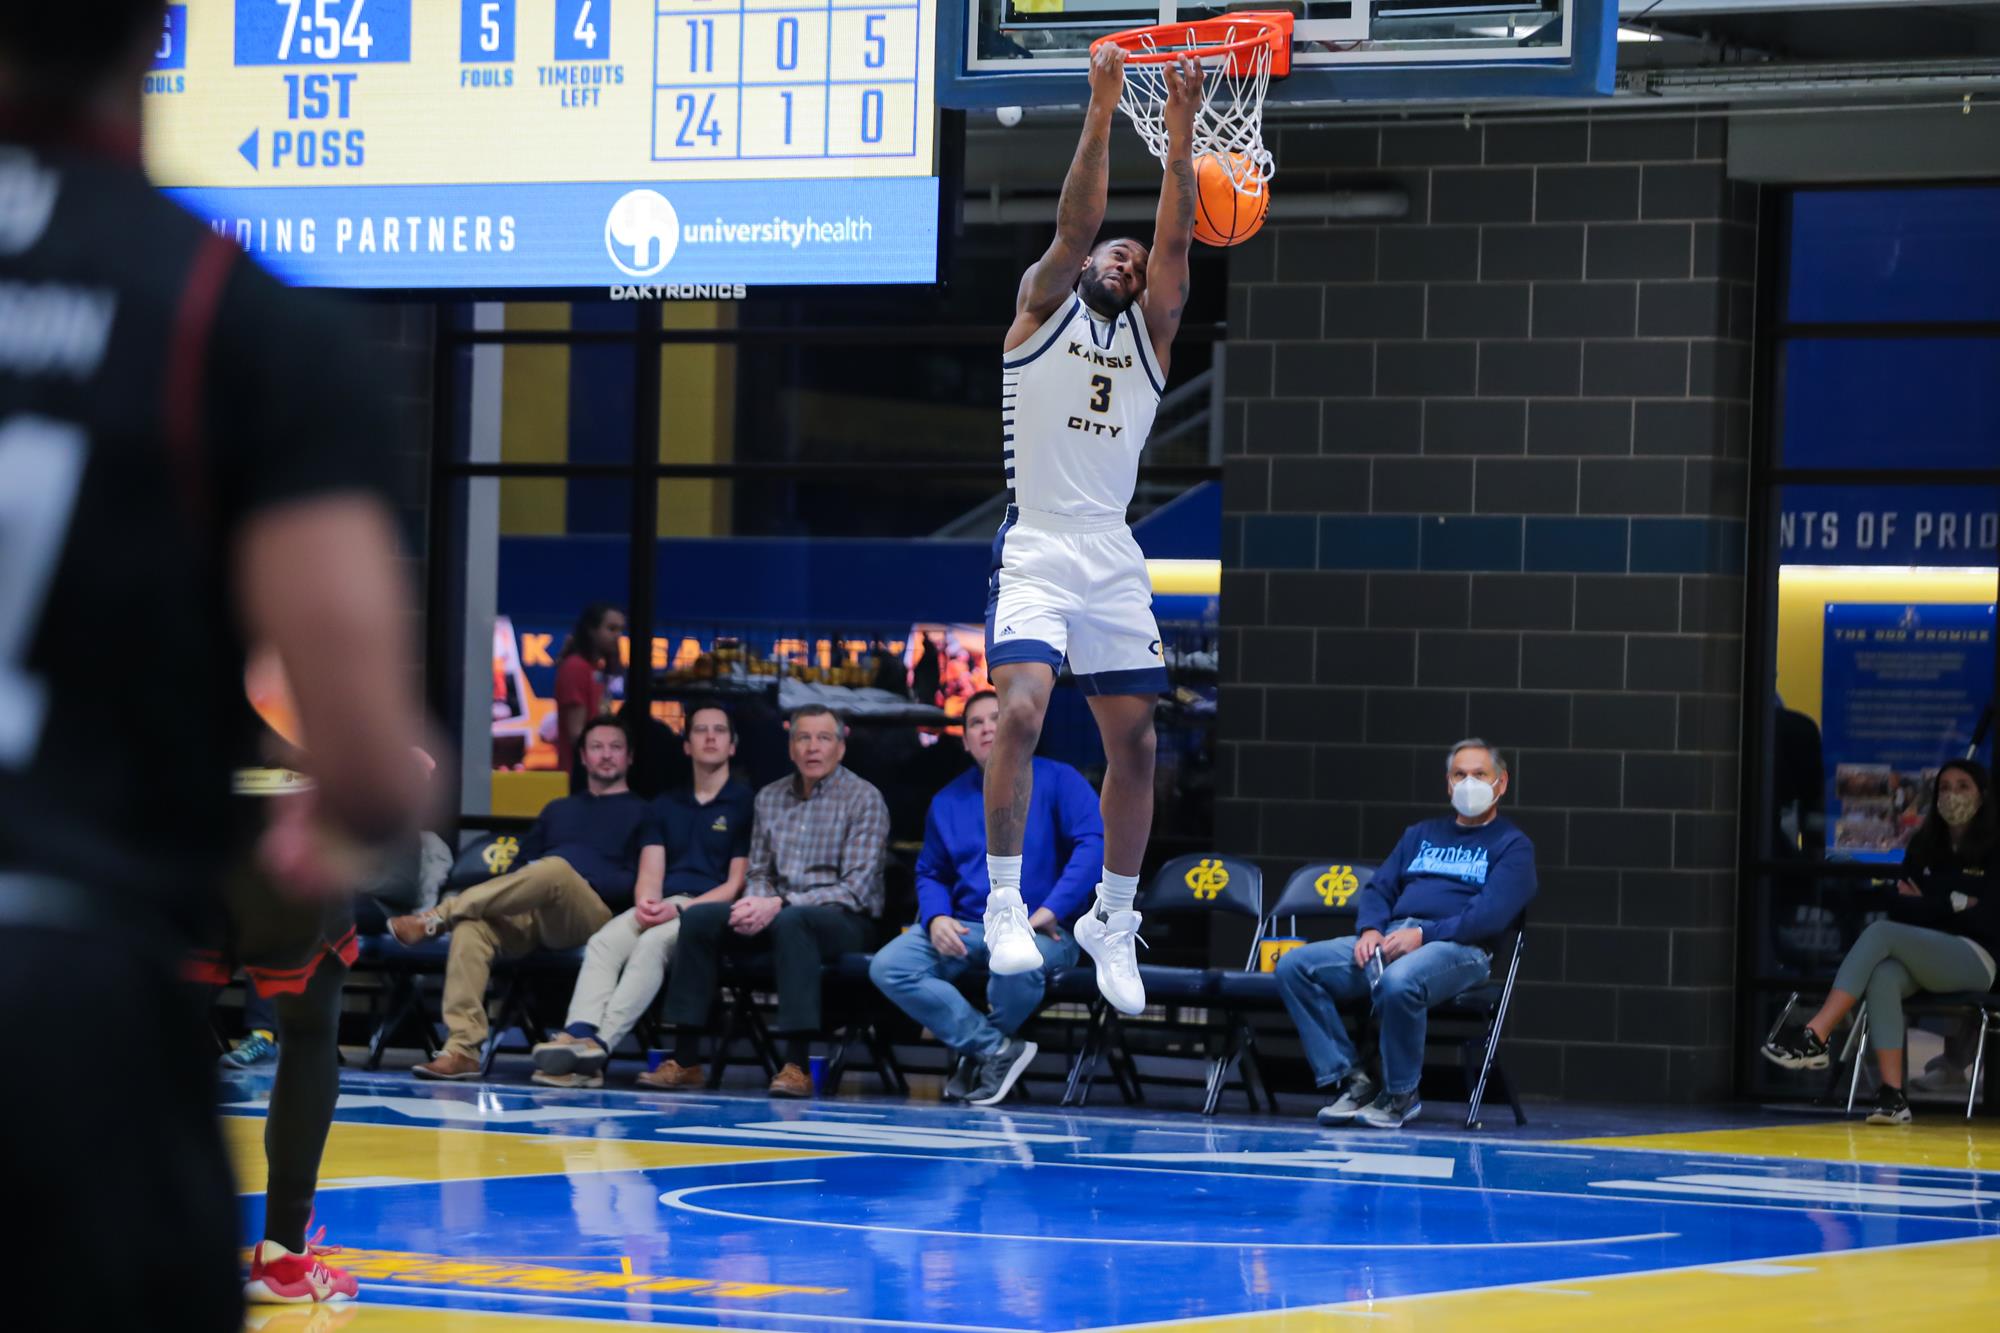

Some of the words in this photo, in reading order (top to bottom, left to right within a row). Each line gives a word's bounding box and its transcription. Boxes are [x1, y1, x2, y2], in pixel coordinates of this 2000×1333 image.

[276, 0, 374, 60] 7:54
[480, 3, 500, 51] 5
[573, 0, 597, 49] 4
[686, 18, 714, 73] 11
[776, 16, 799, 71] 0
[864, 14, 886, 68] 5
[461, 67, 513, 87] FOULS
[537, 64, 625, 86] TIMEOUTS
[283, 73, 358, 119] 1ST
[561, 88, 600, 107] LEFT
[675, 92, 722, 147] 24
[780, 91, 793, 145] 1
[861, 89, 883, 143] 0
[272, 129, 365, 168] POSS
[336, 215, 515, 253] PARTNERS
[609, 283, 747, 300] DAKTRONICS
[1089, 374, 1112, 413] 3
[1067, 416, 1122, 438] CITY
[1856, 511, 1898, 548] OF
